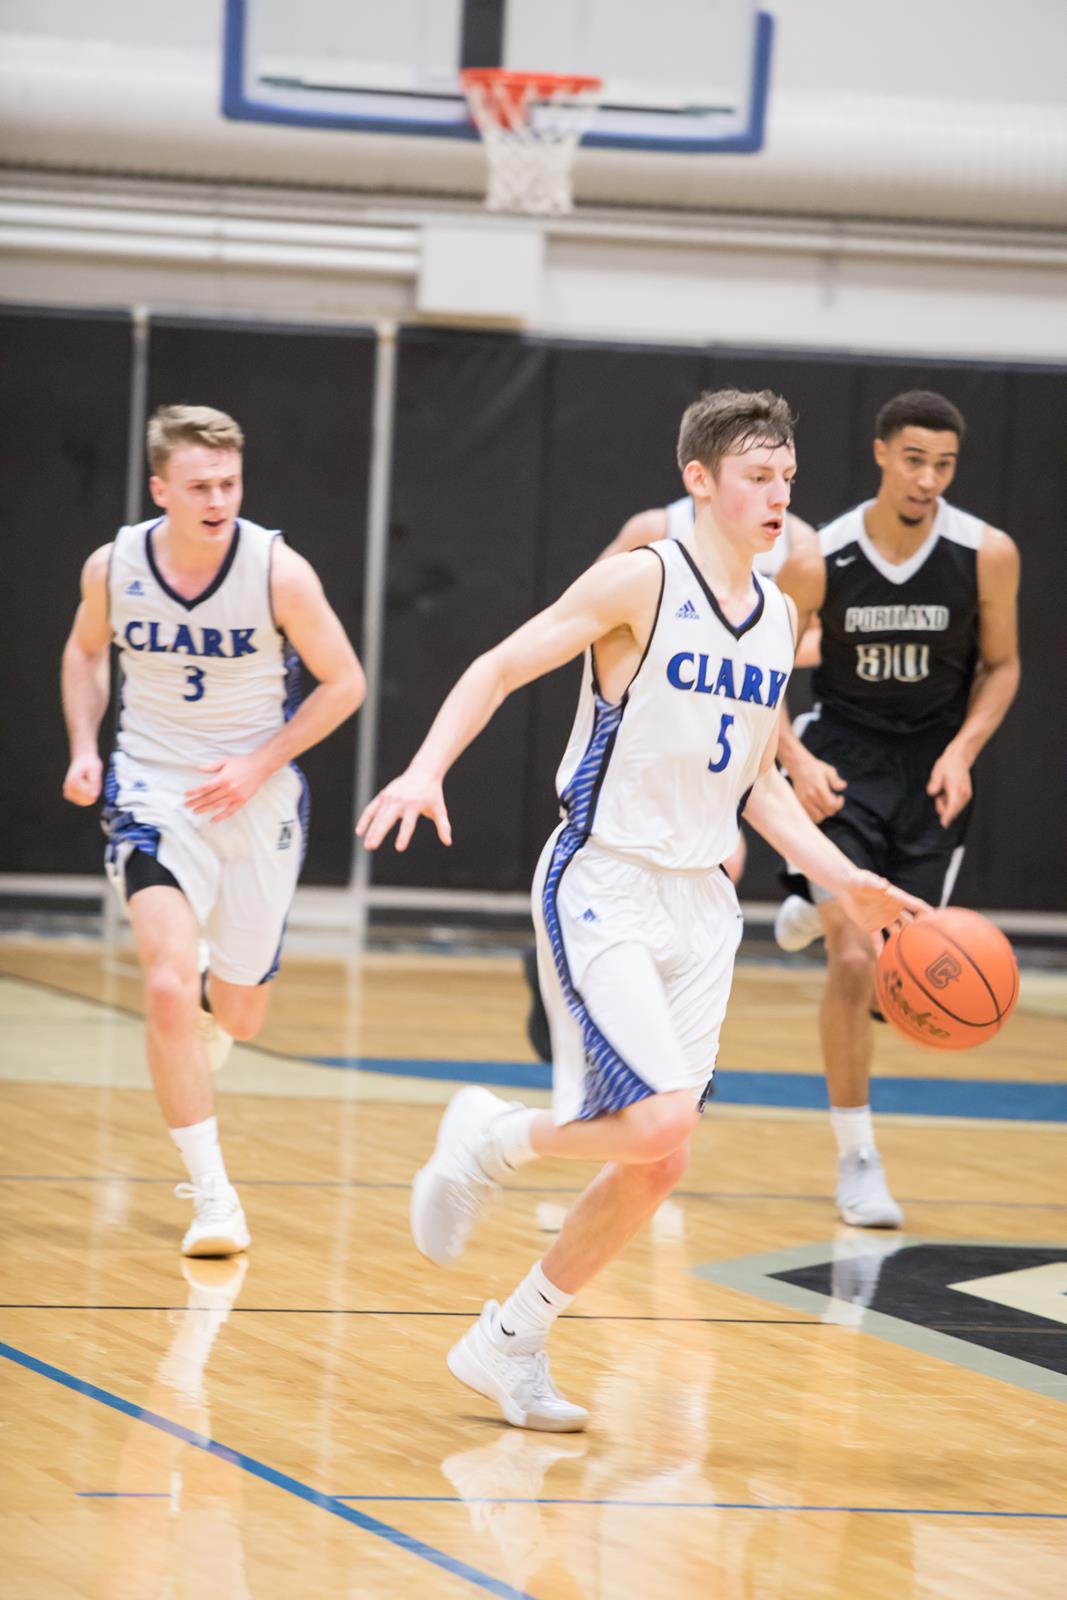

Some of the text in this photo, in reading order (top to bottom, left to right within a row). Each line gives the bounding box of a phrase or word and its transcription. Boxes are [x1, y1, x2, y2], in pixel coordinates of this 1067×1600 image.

[844, 604, 950, 633] PORTLAND
[124, 621, 258, 658] CLARK
[182, 665, 205, 702] 3
[666, 652, 787, 710] CLARK
[708, 713, 735, 773] 5
